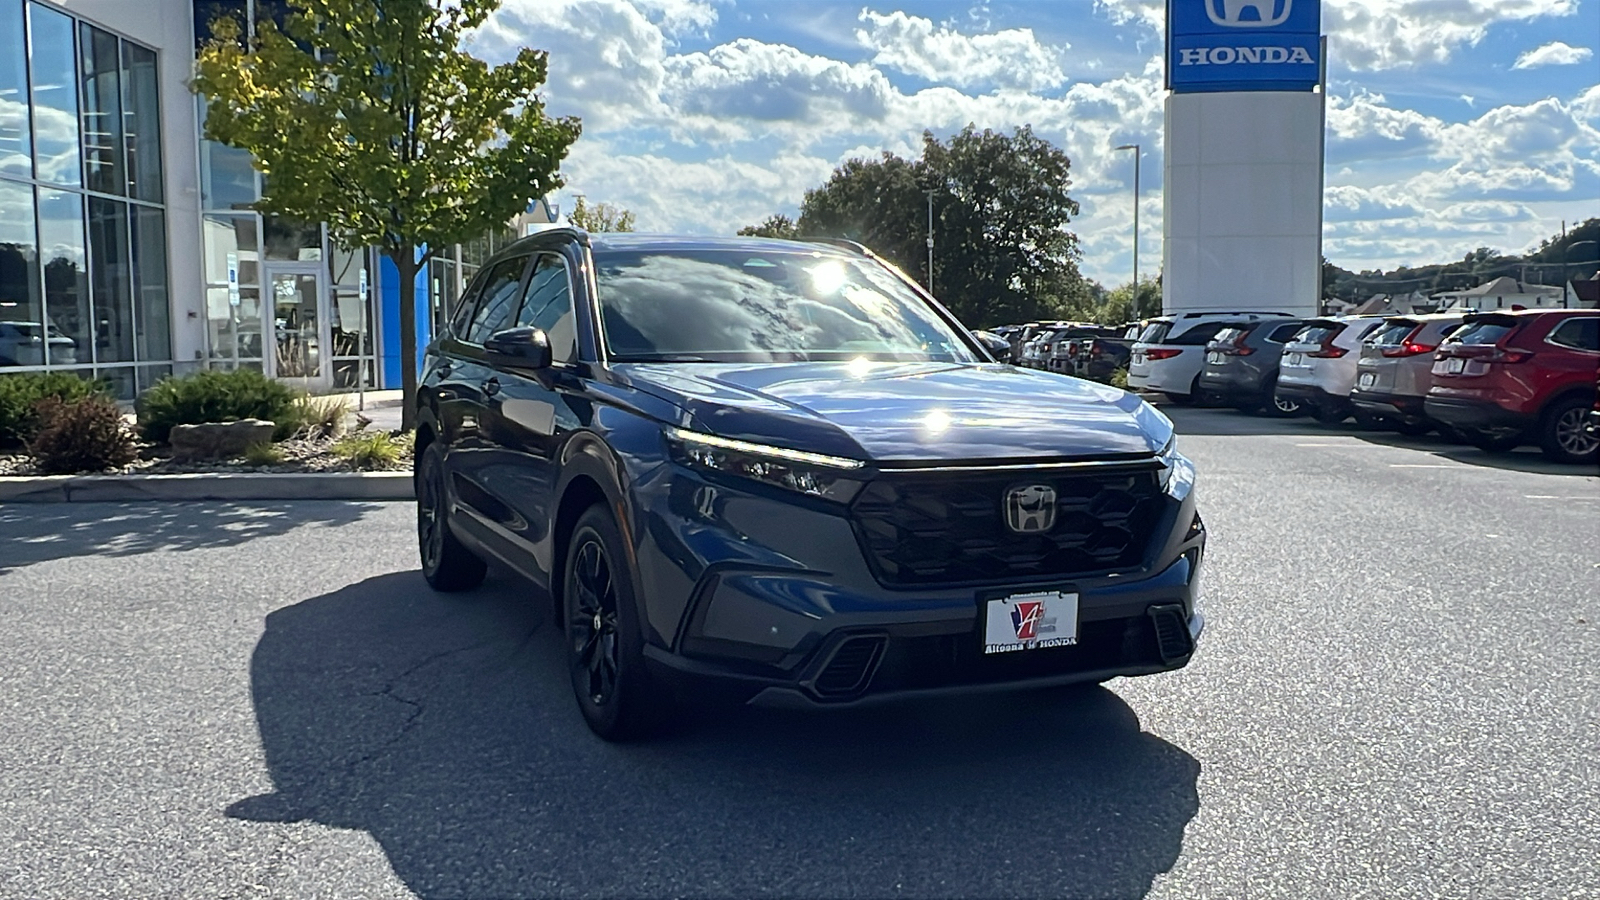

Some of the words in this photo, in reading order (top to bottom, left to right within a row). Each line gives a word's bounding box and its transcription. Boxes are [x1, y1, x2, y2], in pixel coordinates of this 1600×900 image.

[1179, 46, 1315, 66] HONDA
[985, 644, 1024, 655] Altoona
[1039, 637, 1077, 648] HONDA
